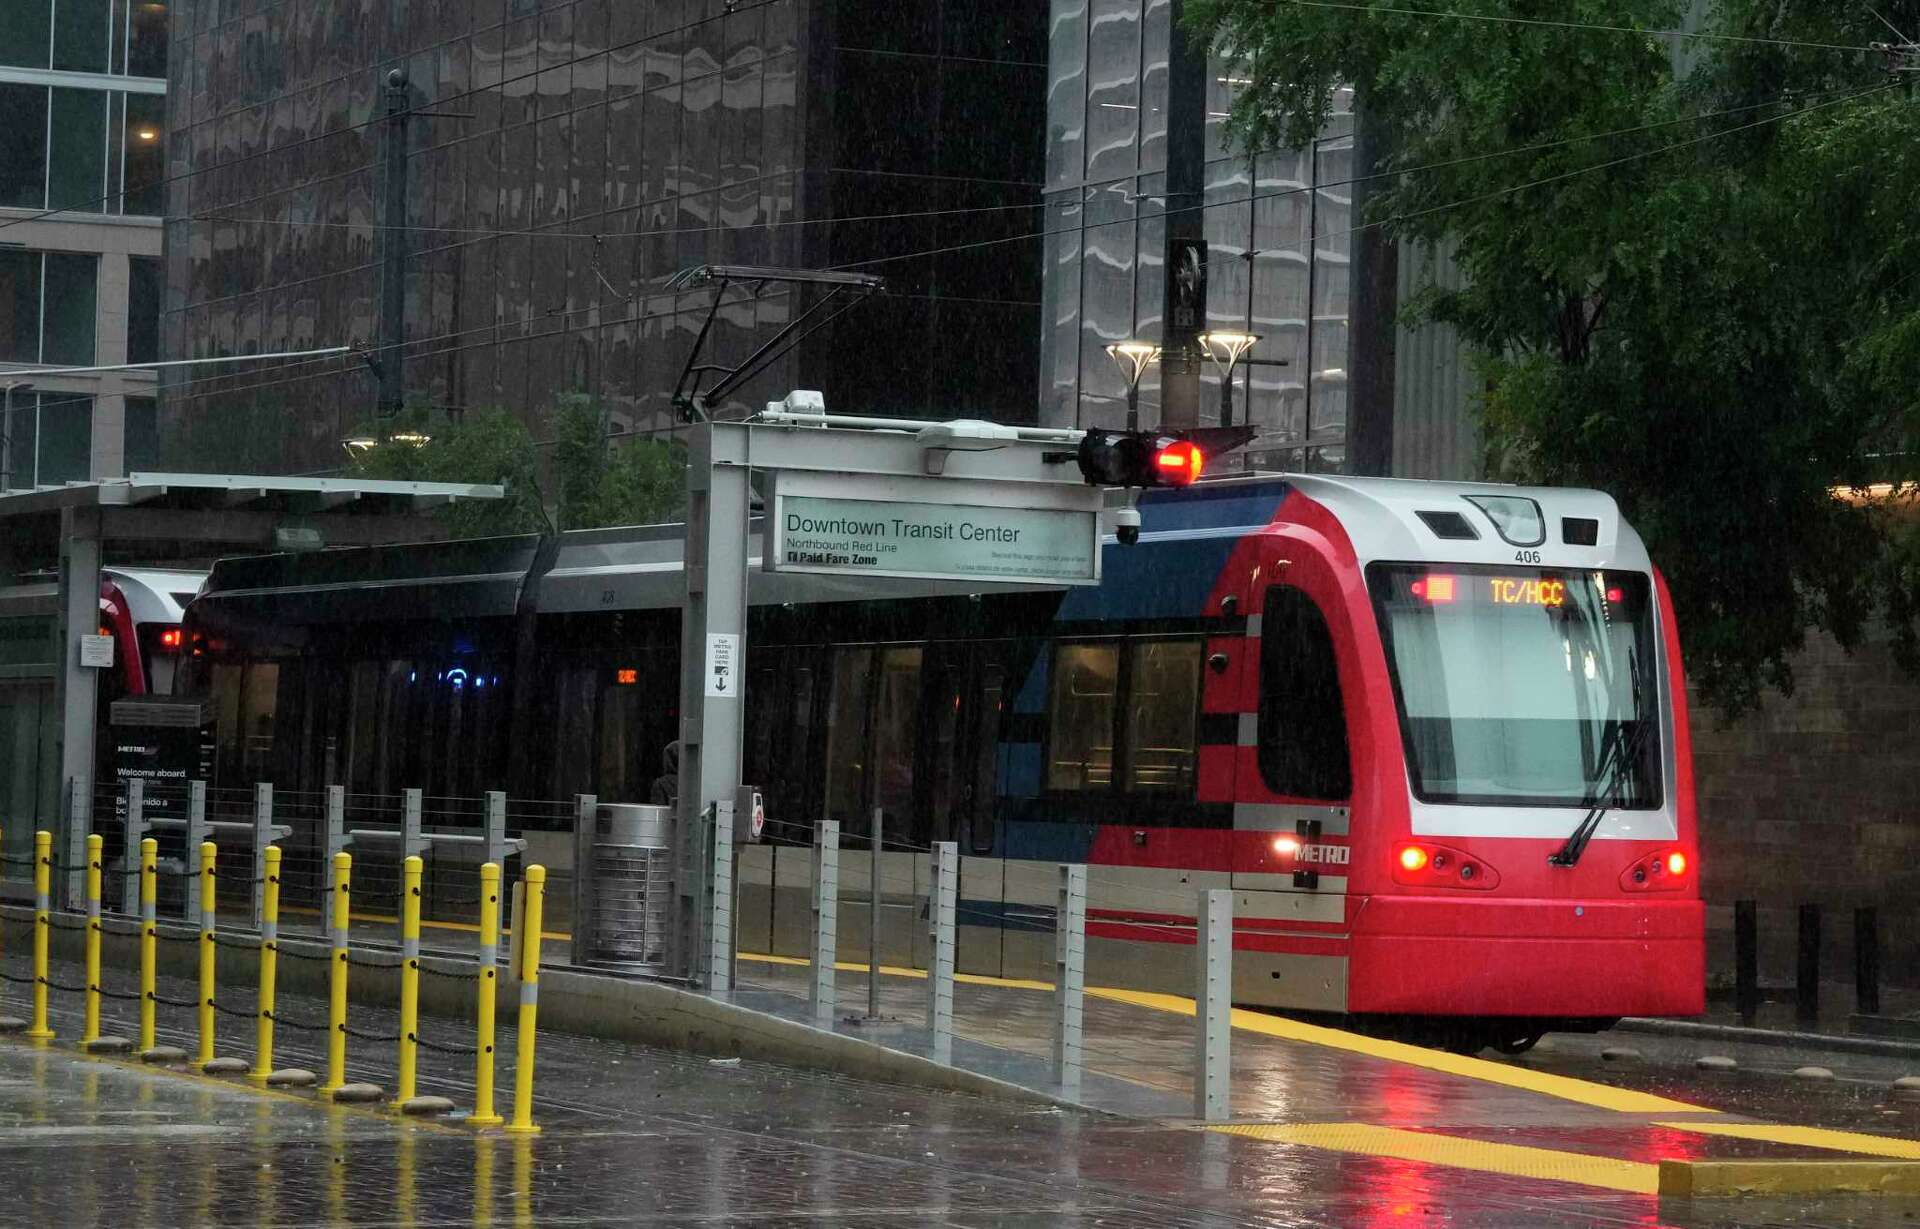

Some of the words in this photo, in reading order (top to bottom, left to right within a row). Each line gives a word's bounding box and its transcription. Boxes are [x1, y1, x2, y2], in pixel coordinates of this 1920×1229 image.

[787, 514, 885, 536] Downtown
[892, 519, 953, 540] Transit
[959, 523, 1020, 543] Center
[786, 538, 848, 551] Northbound
[852, 541, 872, 552] Red
[876, 543, 897, 553] Line
[801, 552, 823, 563] Paid
[826, 553, 849, 564] Fare
[852, 554, 878, 565] Zone
[1515, 550, 1541, 564] 406
[1491, 579, 1564, 607] TC/HCC
[117, 768, 155, 777] Welcome
[116, 797, 160, 806] Binido
[1295, 844, 1350, 864] METRO
